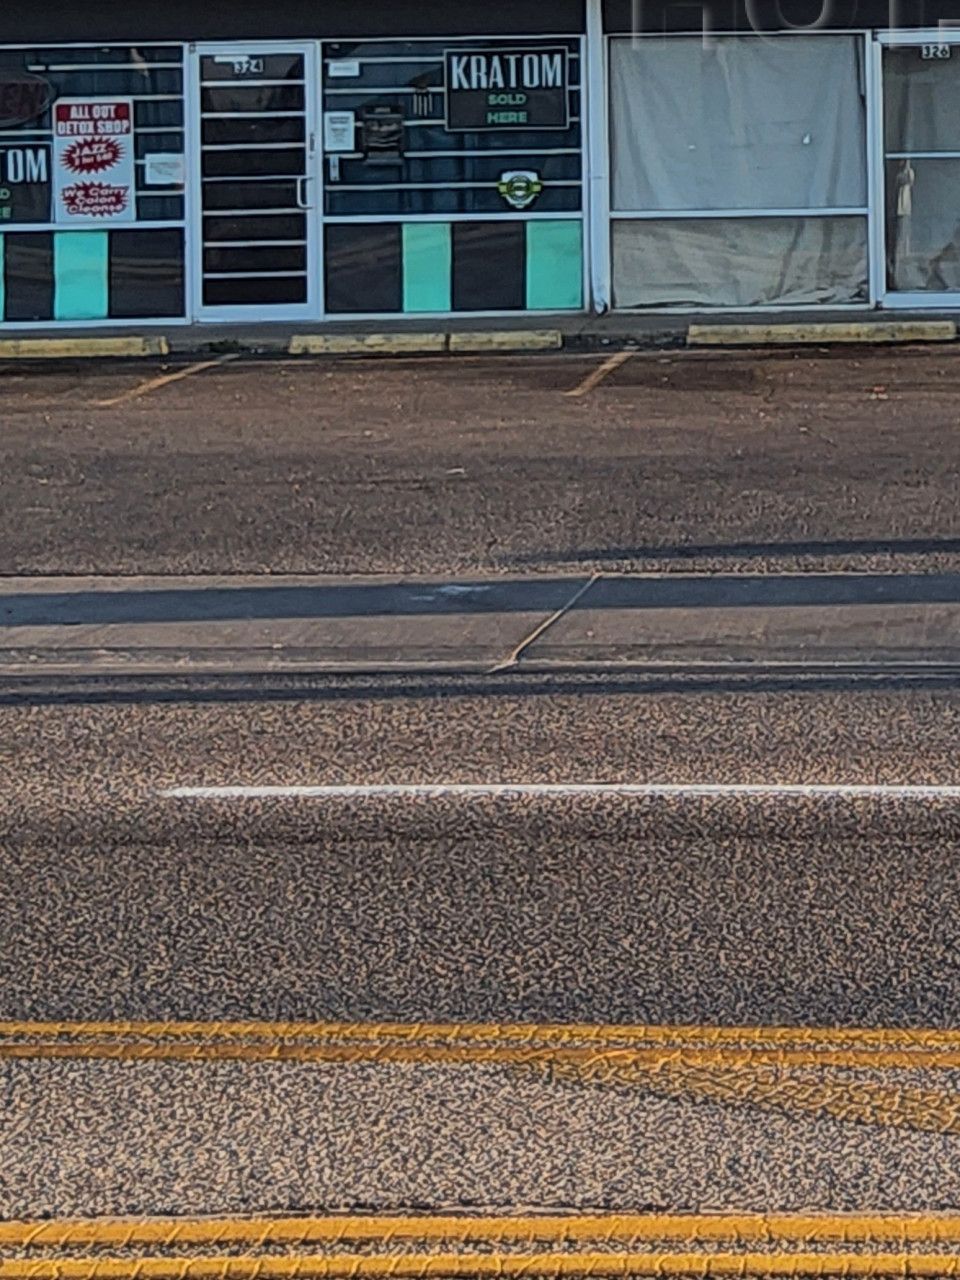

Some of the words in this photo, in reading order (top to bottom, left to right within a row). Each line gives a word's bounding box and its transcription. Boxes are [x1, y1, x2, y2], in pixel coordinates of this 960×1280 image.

[924, 46, 949, 58] 326
[452, 54, 562, 89] KRATOM
[488, 93, 526, 105] SOLD
[70, 105, 90, 118] ALL
[92, 105, 116, 118] OUT
[487, 112, 527, 123] HERE
[57, 121, 95, 134] DETOX
[97, 120, 130, 133] SHOP
[64, 187, 85, 198] We
[75, 195, 116, 205] Colon
[69, 204, 123, 214] Cleanse
